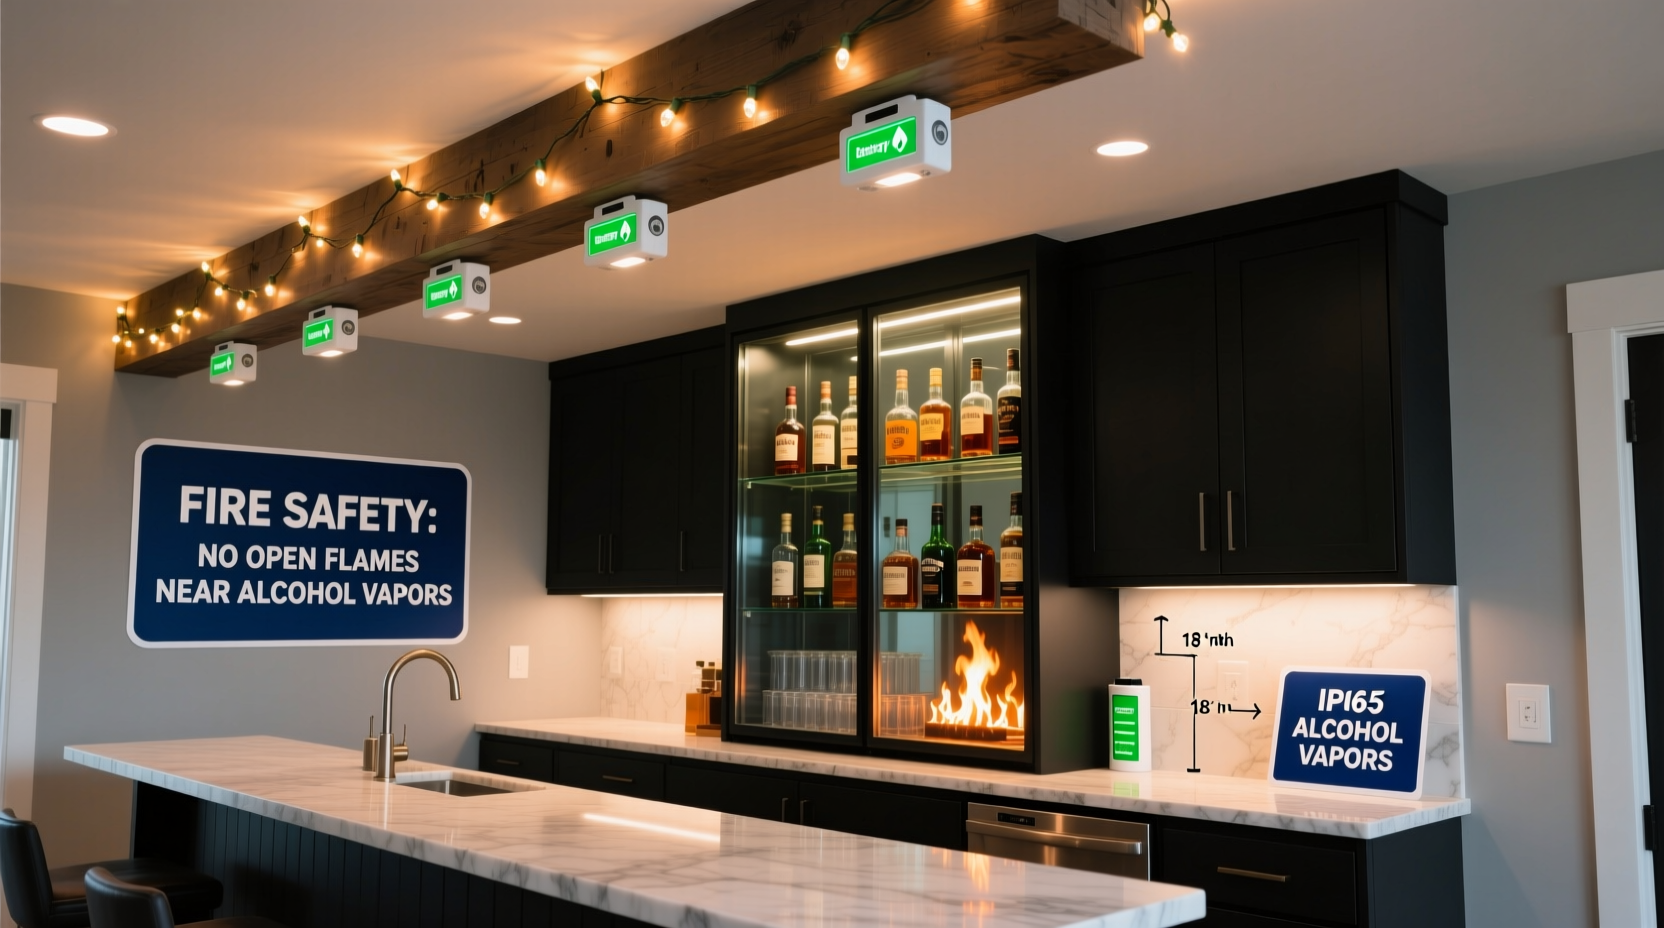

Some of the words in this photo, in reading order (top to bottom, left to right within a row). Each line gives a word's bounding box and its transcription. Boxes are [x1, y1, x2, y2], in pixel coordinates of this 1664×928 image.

[180, 485, 272, 527] FIRE
[282, 491, 437, 534] SAFETY:
[198, 543, 238, 568] NO
[246, 545, 316, 570] OPEN
[325, 547, 419, 573] FLAMES
[155, 578, 230, 604] NEAR
[237, 580, 356, 605] ALCOHOL
[362, 582, 452, 606] VAPORS
[1292, 717, 1403, 744] ALCOHOL
[1299, 744, 1393, 772] VAPORS
